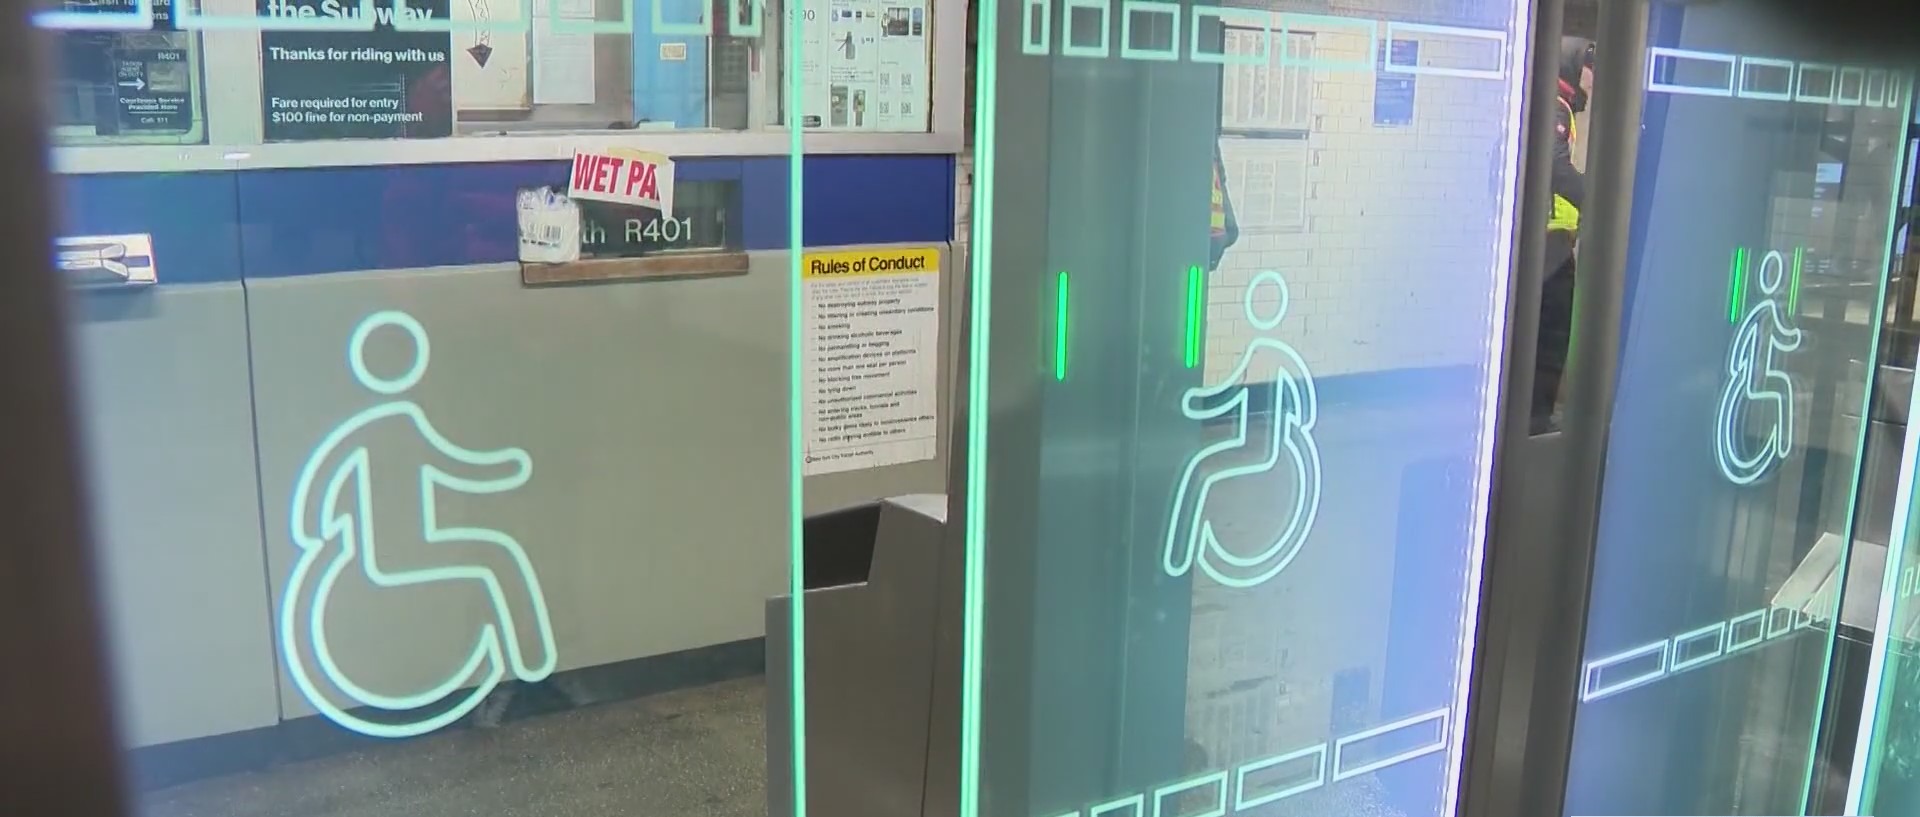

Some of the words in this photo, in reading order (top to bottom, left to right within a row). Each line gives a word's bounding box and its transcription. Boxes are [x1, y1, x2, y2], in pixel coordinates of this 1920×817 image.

[267, 0, 315, 20] the
[269, 47, 325, 61] Thanks
[327, 48, 347, 61] for
[351, 48, 393, 64] riding
[395, 49, 426, 62] with
[428, 51, 445, 62] us
[271, 97, 299, 109] Fare
[300, 97, 349, 110] required
[351, 97, 367, 109] for
[369, 98, 399, 110] entry
[272, 111, 303, 123] $100
[305, 111, 327, 122] fine
[329, 111, 345, 122] for
[347, 111, 423, 124] non-payment
[574, 153, 625, 194] WET
[626, 160, 661, 201] PA
[625, 217, 693, 243] R401
[811, 258, 850, 274] Rules
[853, 257, 866, 272] of
[868, 255, 925, 271] Conduct
